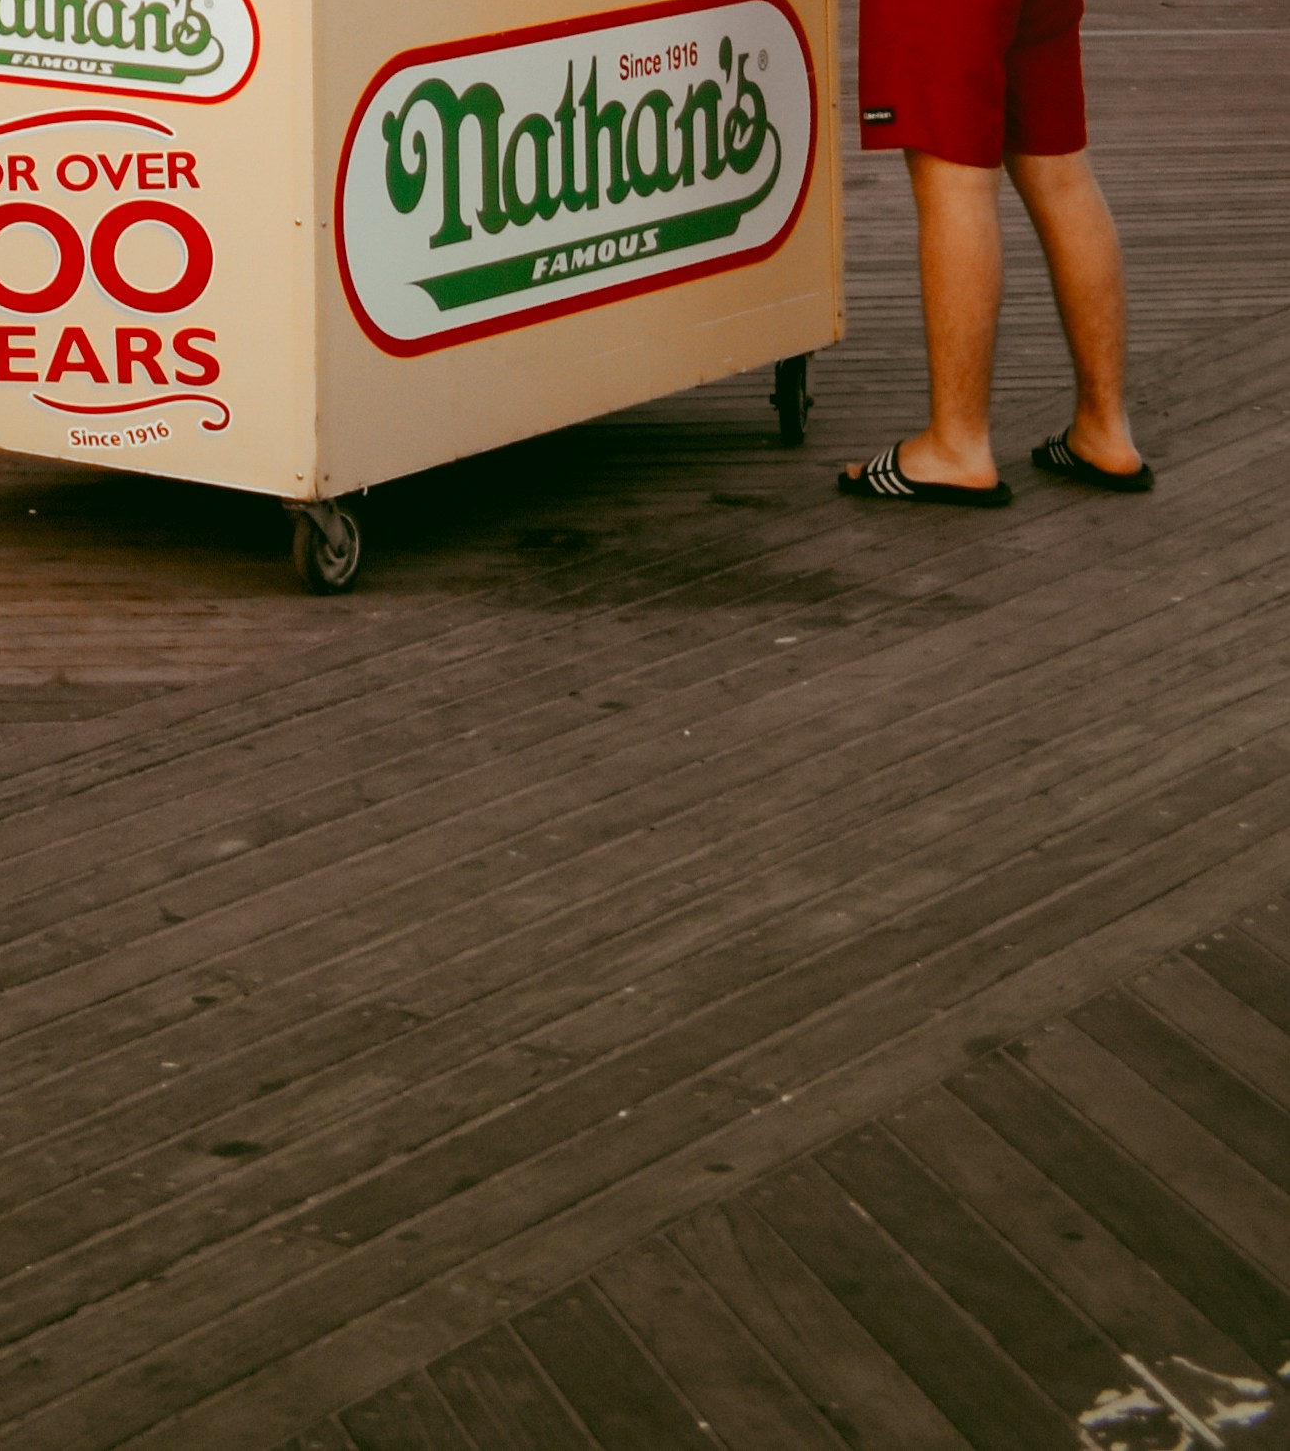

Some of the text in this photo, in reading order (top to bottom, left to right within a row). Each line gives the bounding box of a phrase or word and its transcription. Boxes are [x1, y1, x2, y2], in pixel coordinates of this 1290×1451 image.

[10, 52, 115, 75] FAMOUS
[619, 41, 698, 81] Since 1916
[382, 36, 767, 249] Nathan's
[57, 150, 200, 191] OVER
[531, 226, 660, 281] FAMOUS
[69, 422, 170, 449] Since 1916
